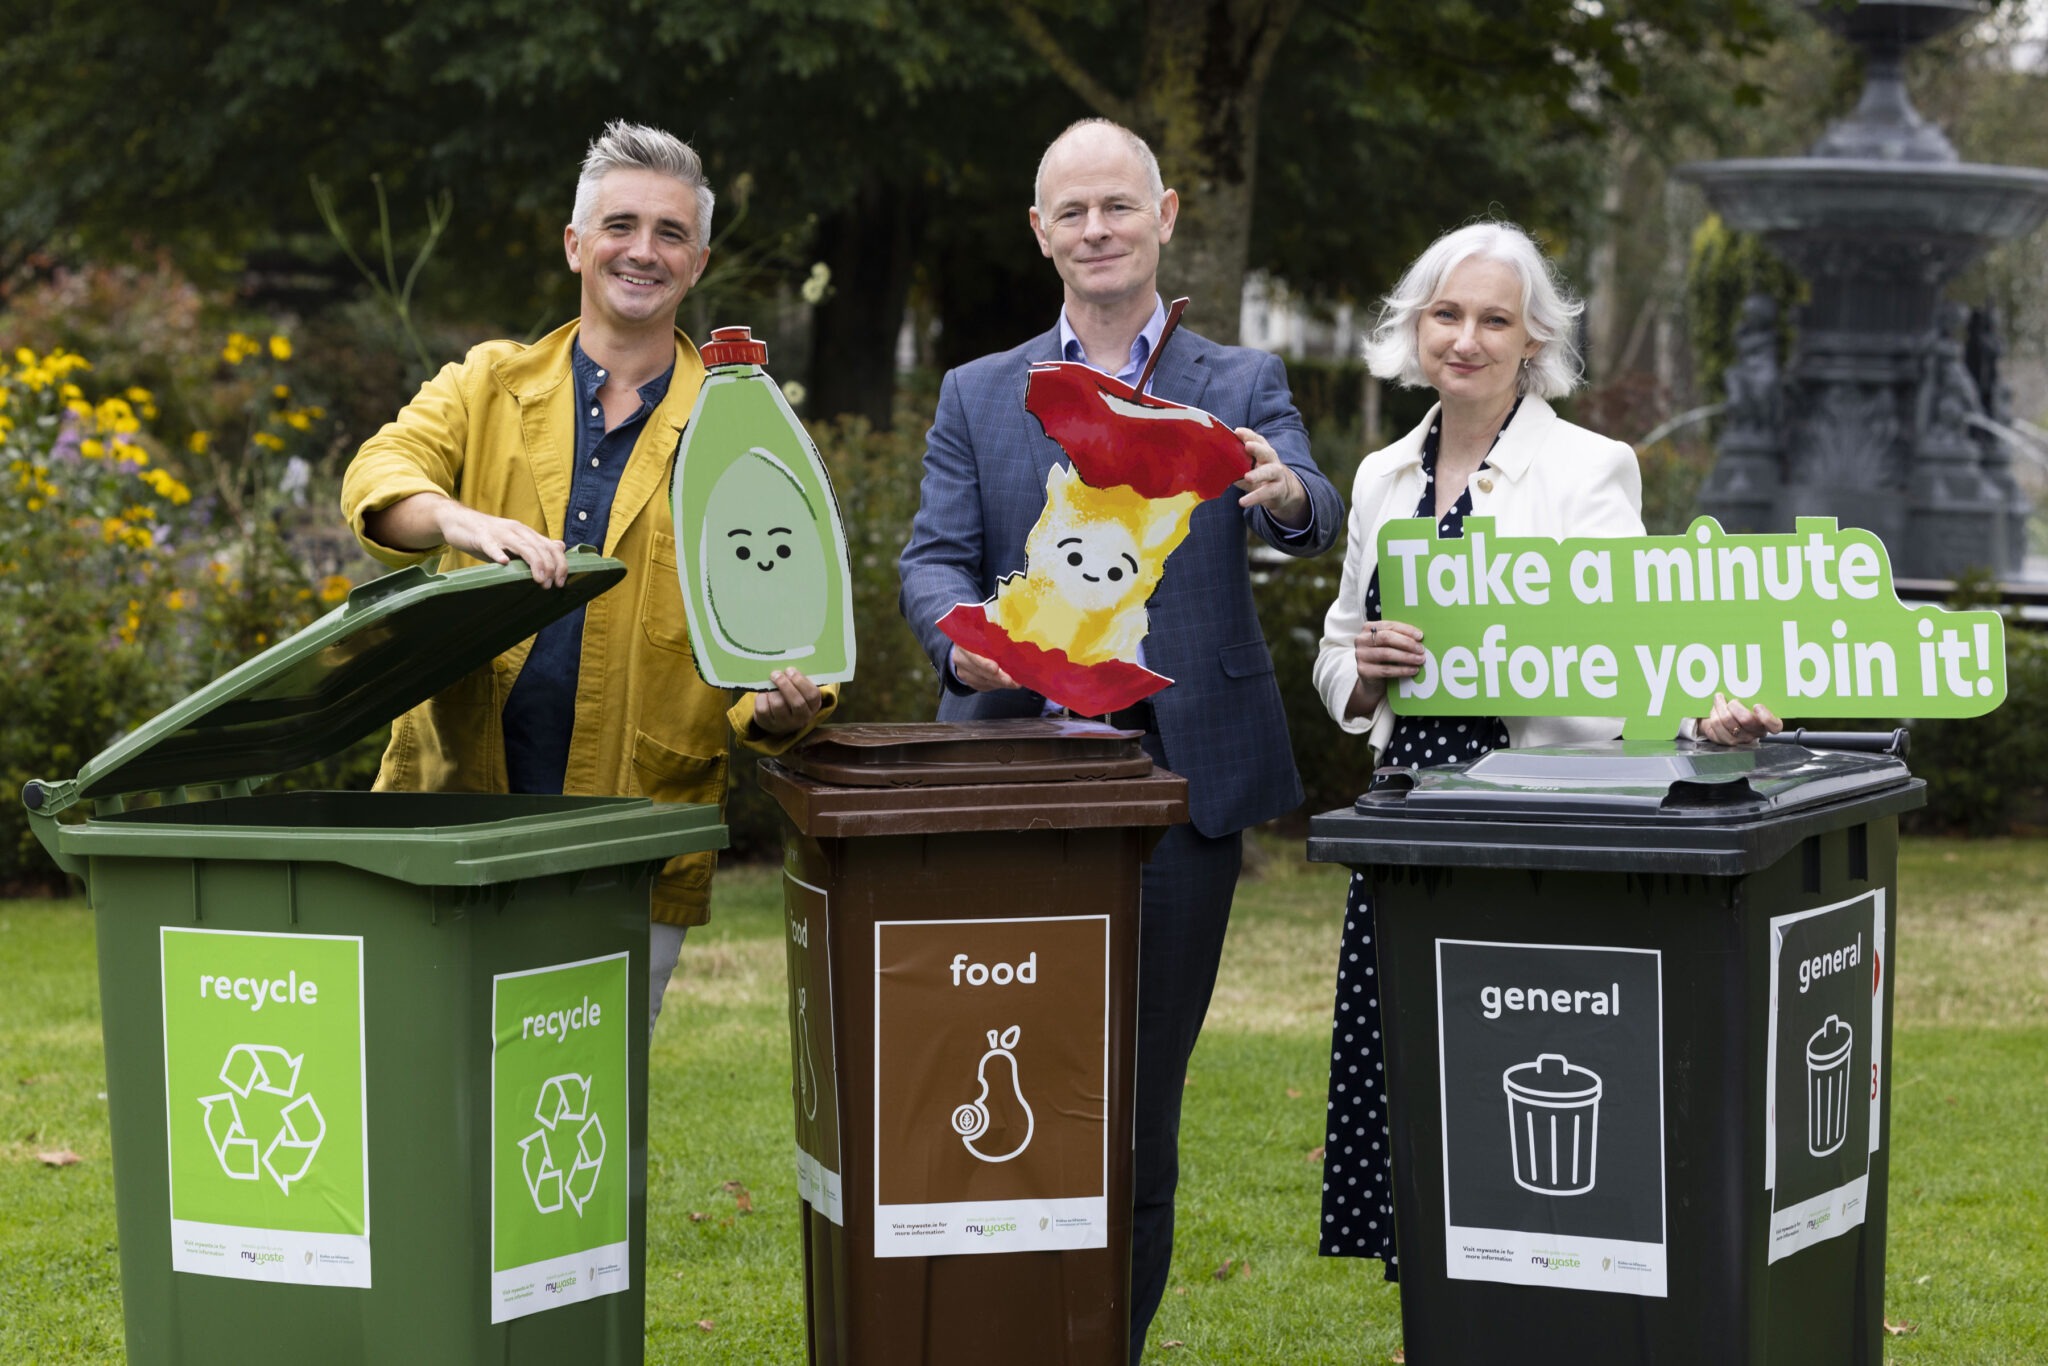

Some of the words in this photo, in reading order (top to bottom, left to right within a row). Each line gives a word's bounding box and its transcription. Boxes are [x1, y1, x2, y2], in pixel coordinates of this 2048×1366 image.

[1387, 532, 1551, 606] Take
[1569, 550, 1614, 604] a
[1633, 525, 1880, 602] minute
[1399, 624, 1619, 699] before
[1635, 644, 1762, 716] you
[1783, 619, 1898, 698] bin
[1917, 617, 1994, 698] it!
[790, 909, 808, 949] ood
[949, 951, 1037, 987] food
[1799, 931, 1862, 994] general
[200, 969, 318, 1012] recycle
[1480, 982, 1620, 1020] general
[522, 995, 601, 1044] recycle
[965, 1222, 1017, 1236] mywaste
[240, 1251, 285, 1264] mywaste
[1531, 1256, 1581, 1269] mywaste
[545, 1277, 577, 1293] mywaste
